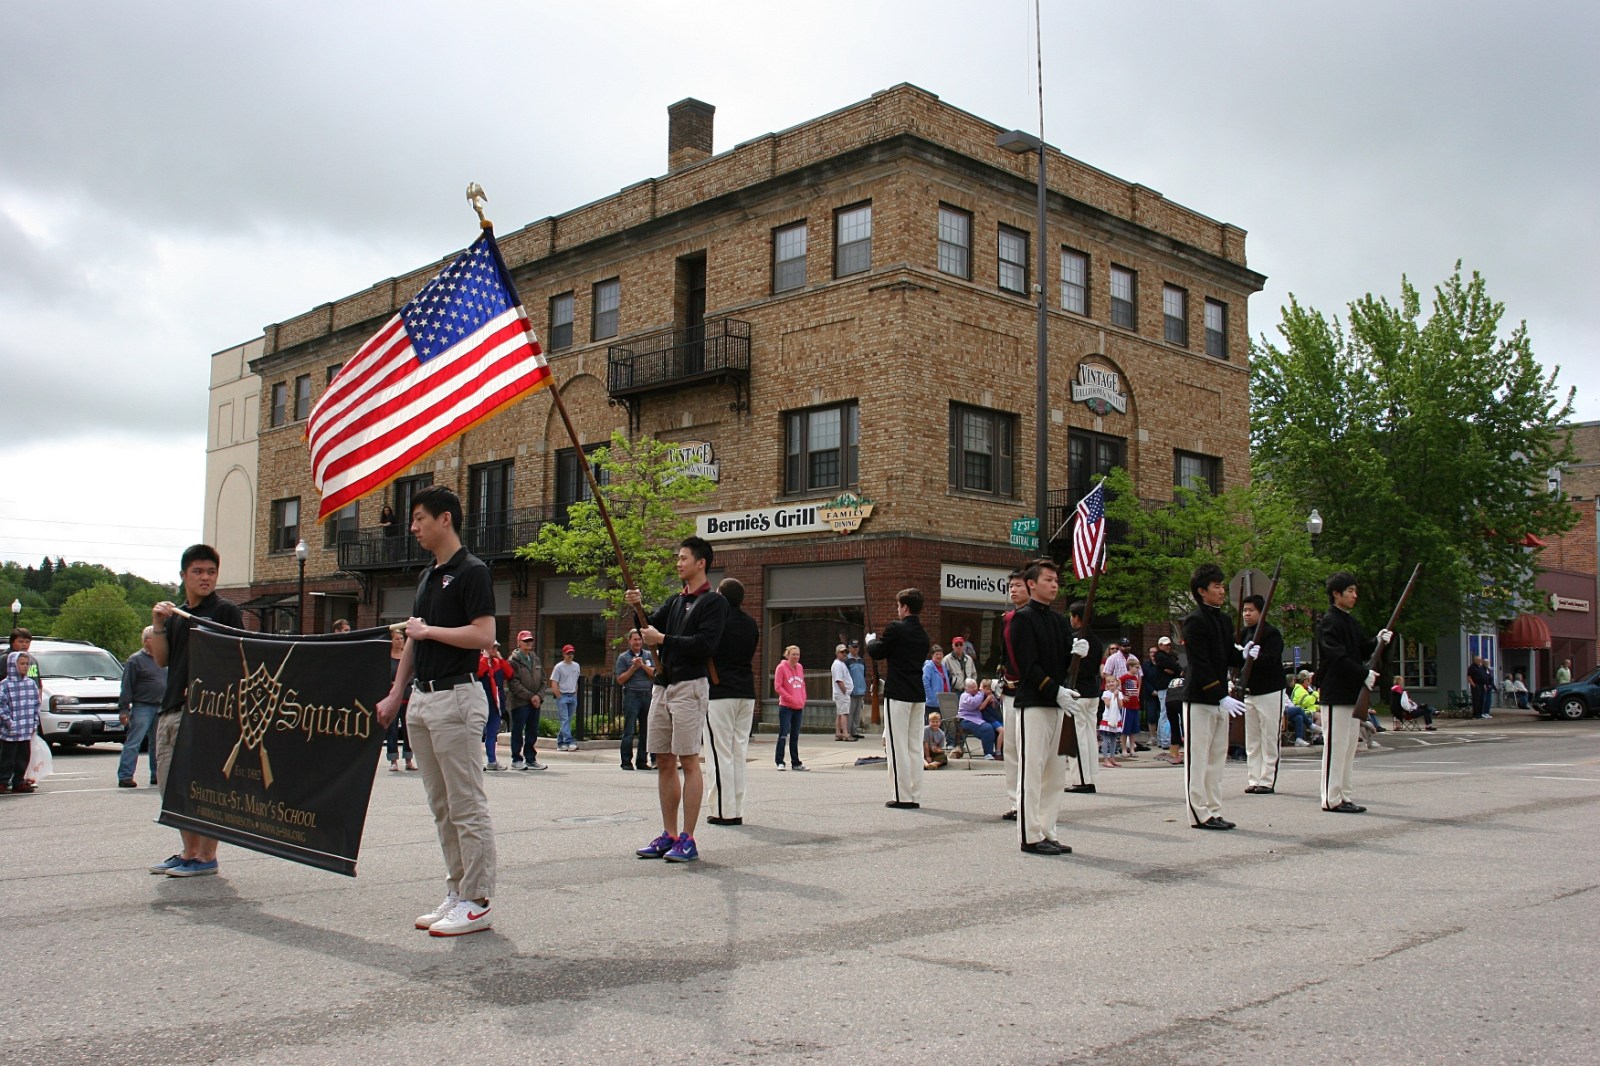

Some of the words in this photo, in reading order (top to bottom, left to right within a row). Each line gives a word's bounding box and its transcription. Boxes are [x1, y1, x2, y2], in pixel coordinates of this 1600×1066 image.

[1081, 365, 1118, 393] VINTAGE
[707, 512, 770, 534] Bernie's
[774, 507, 815, 528] Grill
[826, 509, 864, 519] FAMILY
[834, 520, 857, 528] DINING
[1010, 534, 1030, 546] CENTRAL
[1031, 537, 1039, 548] AVE
[946, 573, 996, 593] Bernie's
[256, 688, 262, 697] C
[187, 677, 235, 721] Crack
[275, 688, 374, 742] Squad
[253, 712, 258, 721] S
[245, 793, 276, 820] MARY'S
[277, 801, 317, 828] SCHOOL
